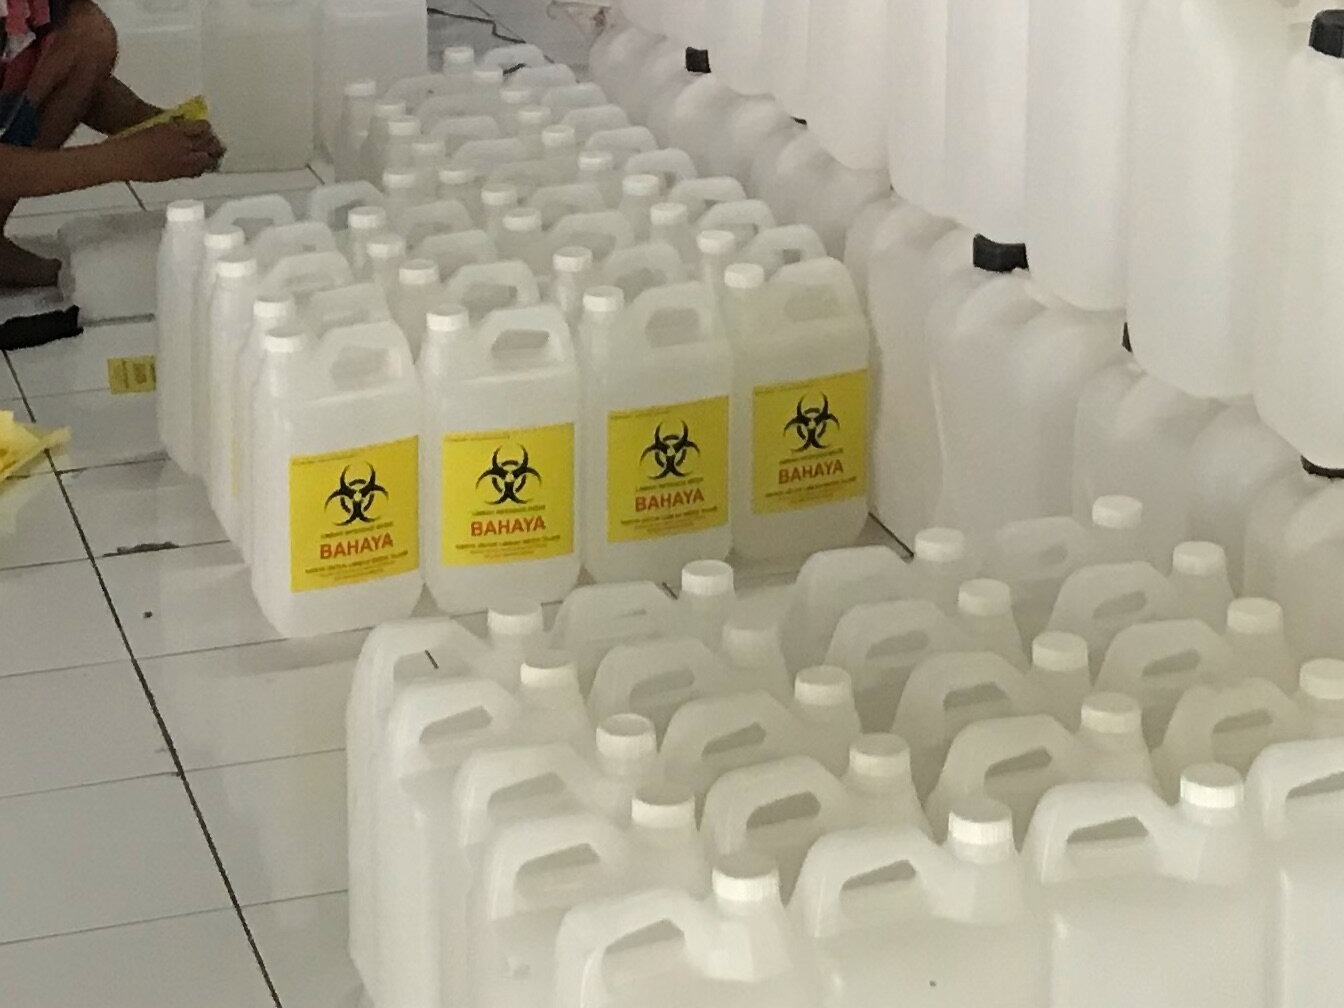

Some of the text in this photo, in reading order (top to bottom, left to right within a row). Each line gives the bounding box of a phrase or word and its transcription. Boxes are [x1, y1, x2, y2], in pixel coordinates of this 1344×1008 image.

[778, 459, 843, 484] BAHAYA
[635, 488, 704, 512] BAHAYA
[471, 515, 546, 536] BAHAYA
[320, 532, 393, 559] BAHAYA
